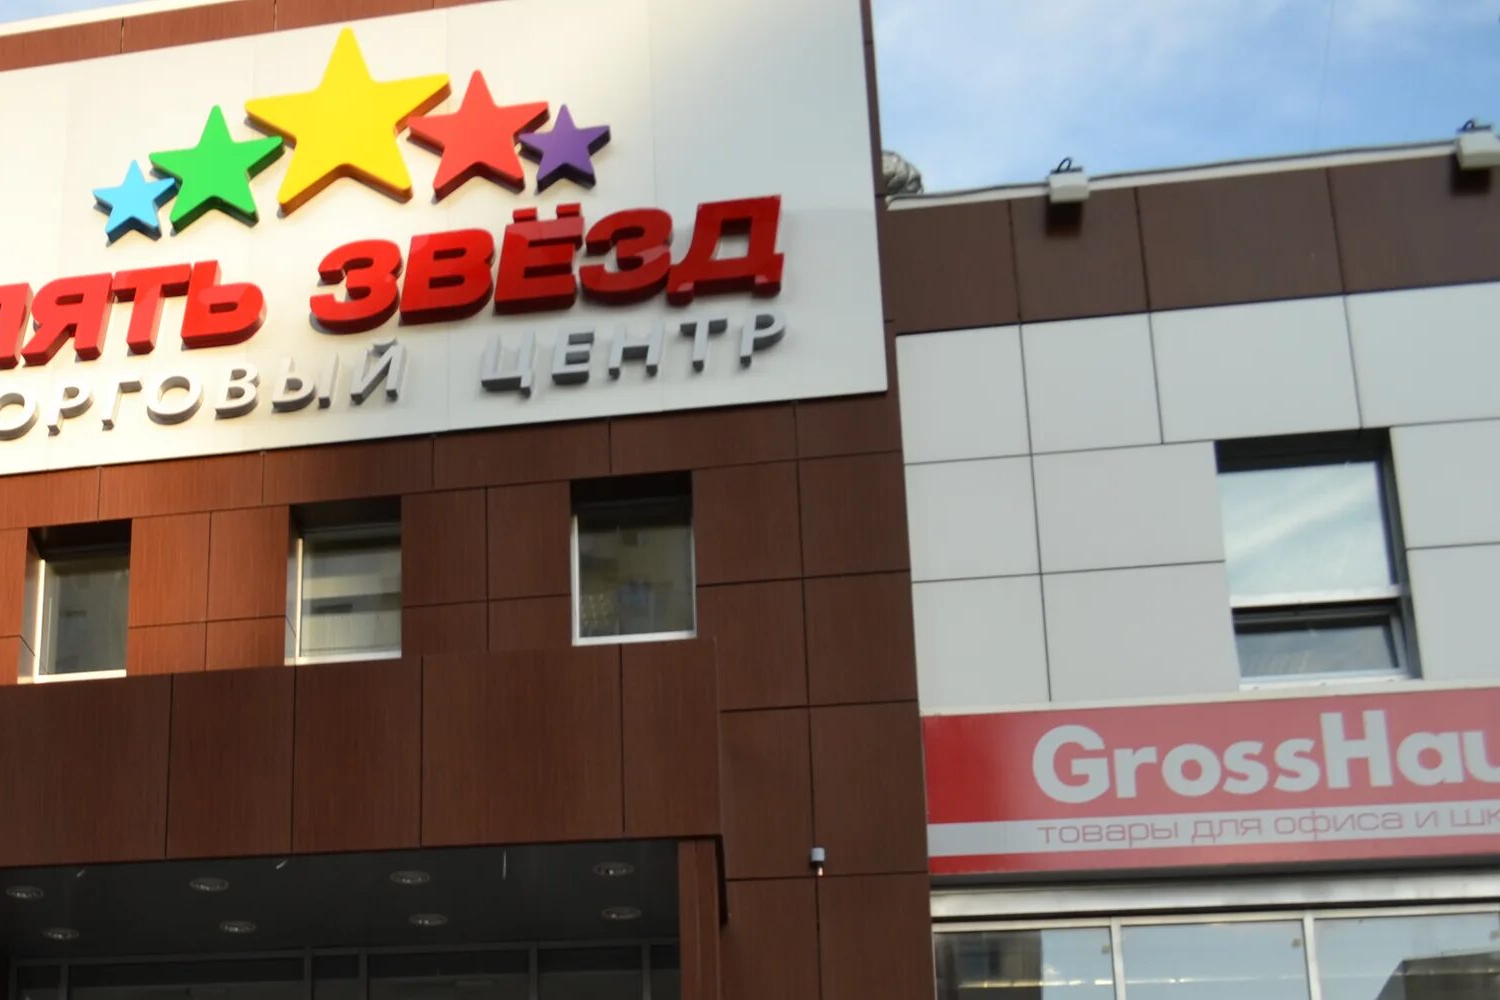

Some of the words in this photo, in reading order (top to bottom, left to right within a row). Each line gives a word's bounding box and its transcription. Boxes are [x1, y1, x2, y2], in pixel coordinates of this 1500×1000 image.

[308, 195, 784, 334] ЗВЁЗД
[479, 312, 787, 397] ЦЕНТР
[1037, 820, 1180, 848] товары
[1191, 815, 1263, 844] для
[1274, 808, 1404, 842] офиса
[1414, 809, 1439, 829] и
